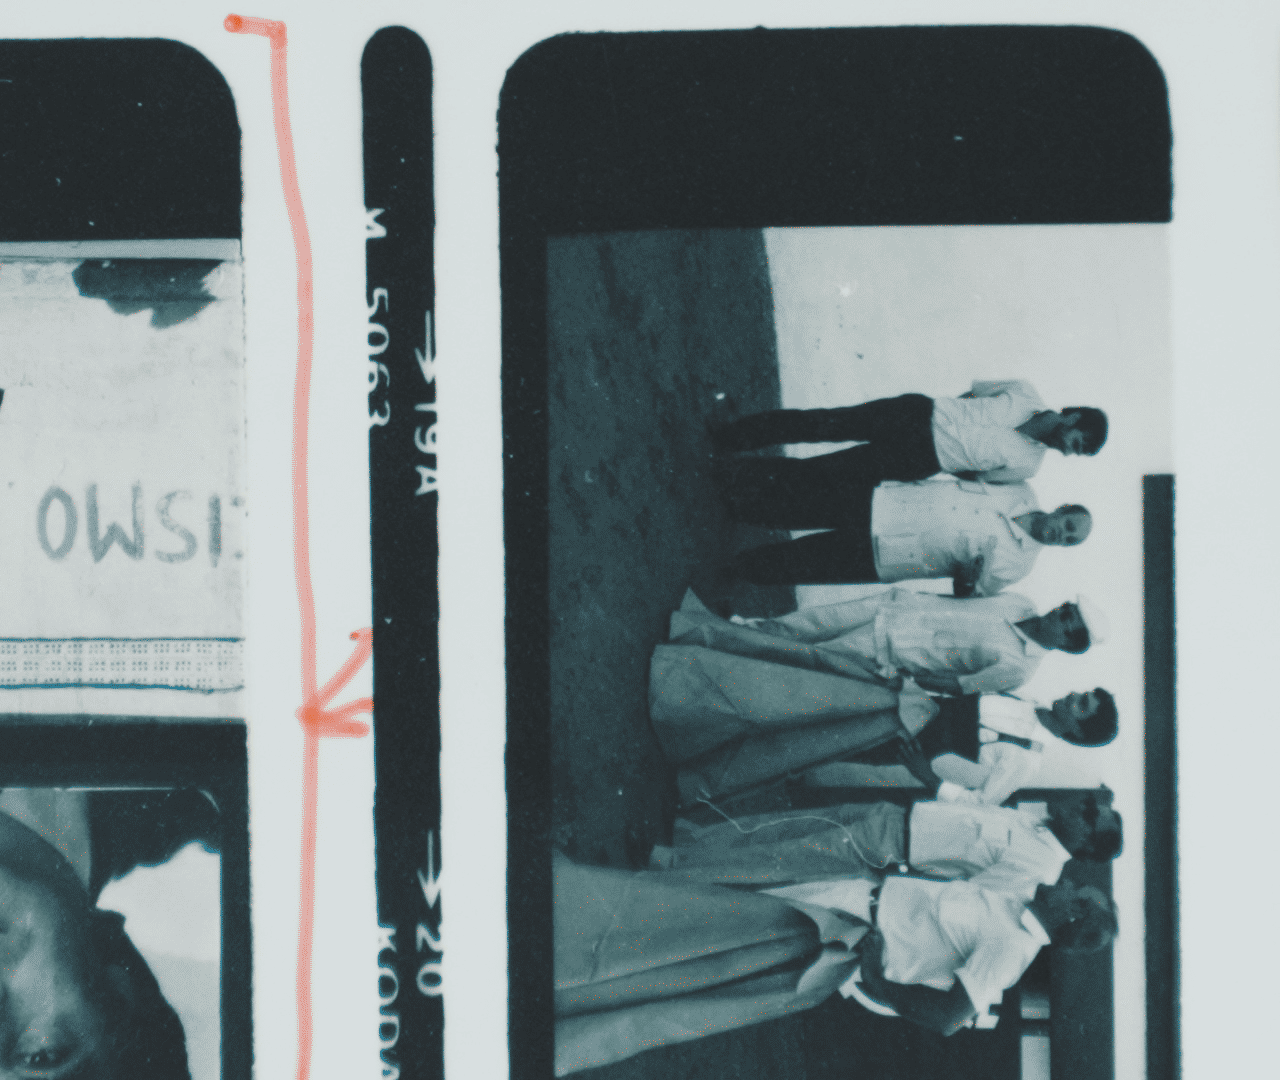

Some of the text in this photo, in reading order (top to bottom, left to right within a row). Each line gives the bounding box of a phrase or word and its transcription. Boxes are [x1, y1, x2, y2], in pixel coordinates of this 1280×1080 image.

[414, 401, 441, 497] 19A
[36, 480, 244, 569] ISMO
[415, 923, 444, 997] 20
